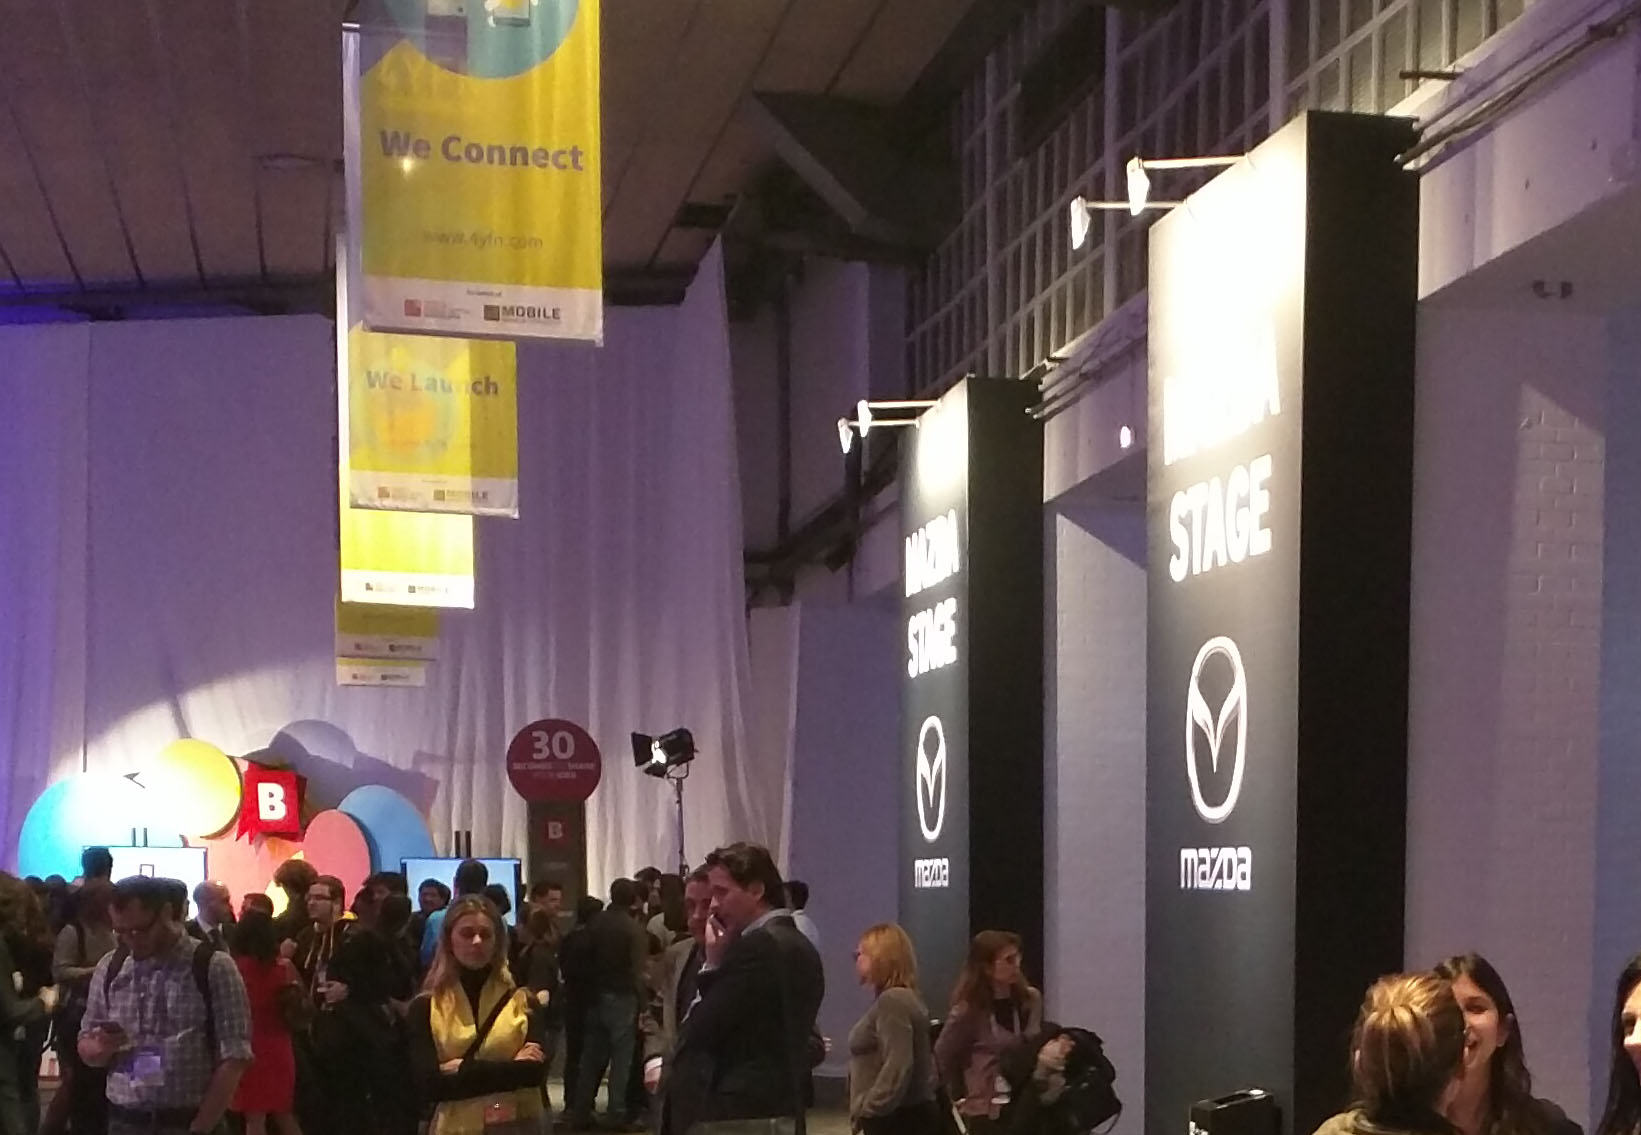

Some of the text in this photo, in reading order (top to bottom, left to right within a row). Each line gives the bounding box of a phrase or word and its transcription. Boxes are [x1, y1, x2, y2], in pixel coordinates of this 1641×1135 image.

[379, 130, 584, 171] We Connect
[502, 305, 561, 320] MOBILE
[366, 370, 499, 397] We Lauch
[1169, 454, 1272, 582] STAGE
[905, 508, 959, 598] MAZDA
[908, 597, 957, 679] STAGE
[531, 730, 575, 760] 30
[257, 782, 287, 820] B
[548, 821, 563, 839] B
